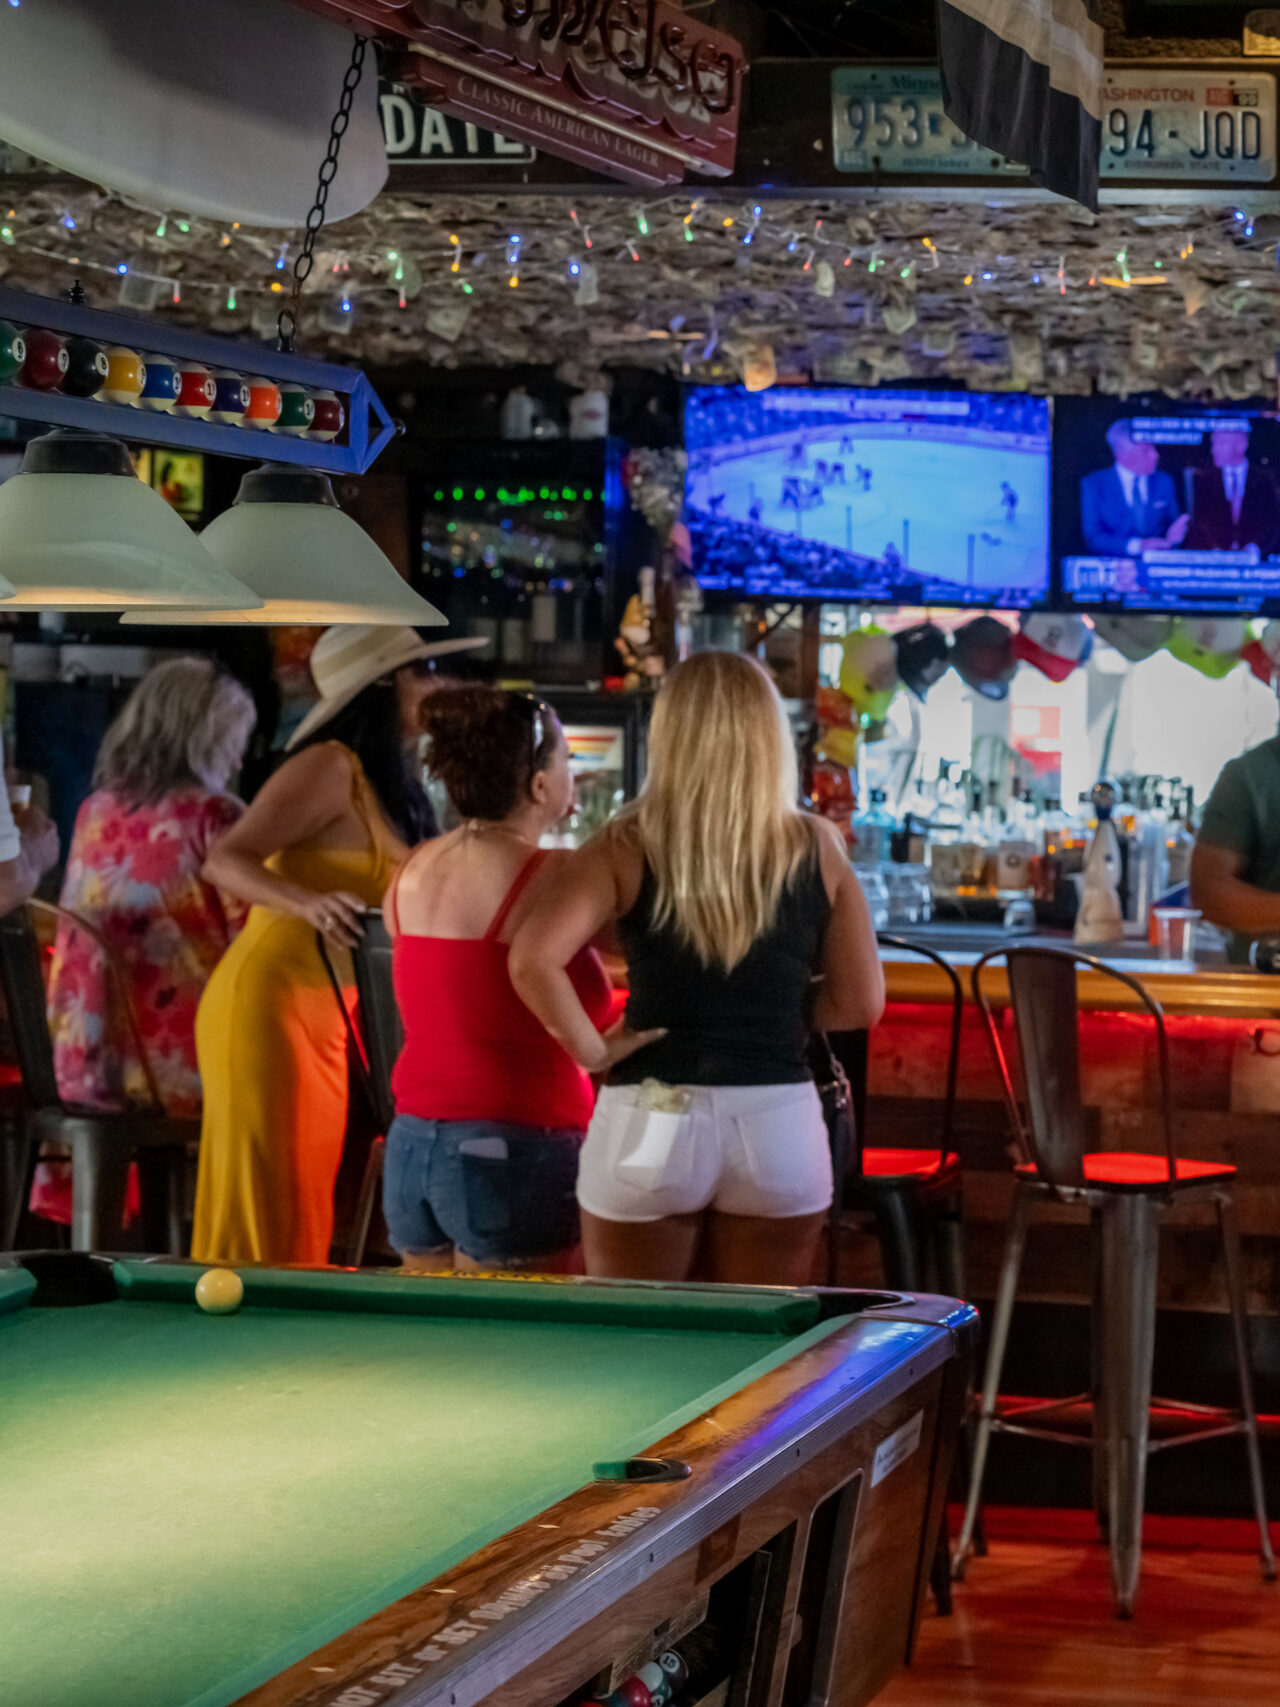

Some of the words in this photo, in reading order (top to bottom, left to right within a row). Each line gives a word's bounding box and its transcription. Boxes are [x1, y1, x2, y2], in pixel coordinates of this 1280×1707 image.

[1101, 87, 1195, 102] ASHINGTON
[457, 75, 529, 118] CLASSIC
[531, 104, 610, 151] AMERICAN
[615, 137, 660, 170] LAGER
[368, 1661, 424, 1687] SIT
[431, 1619, 489, 1645] SET
[662, 1655, 677, 1668] 15
